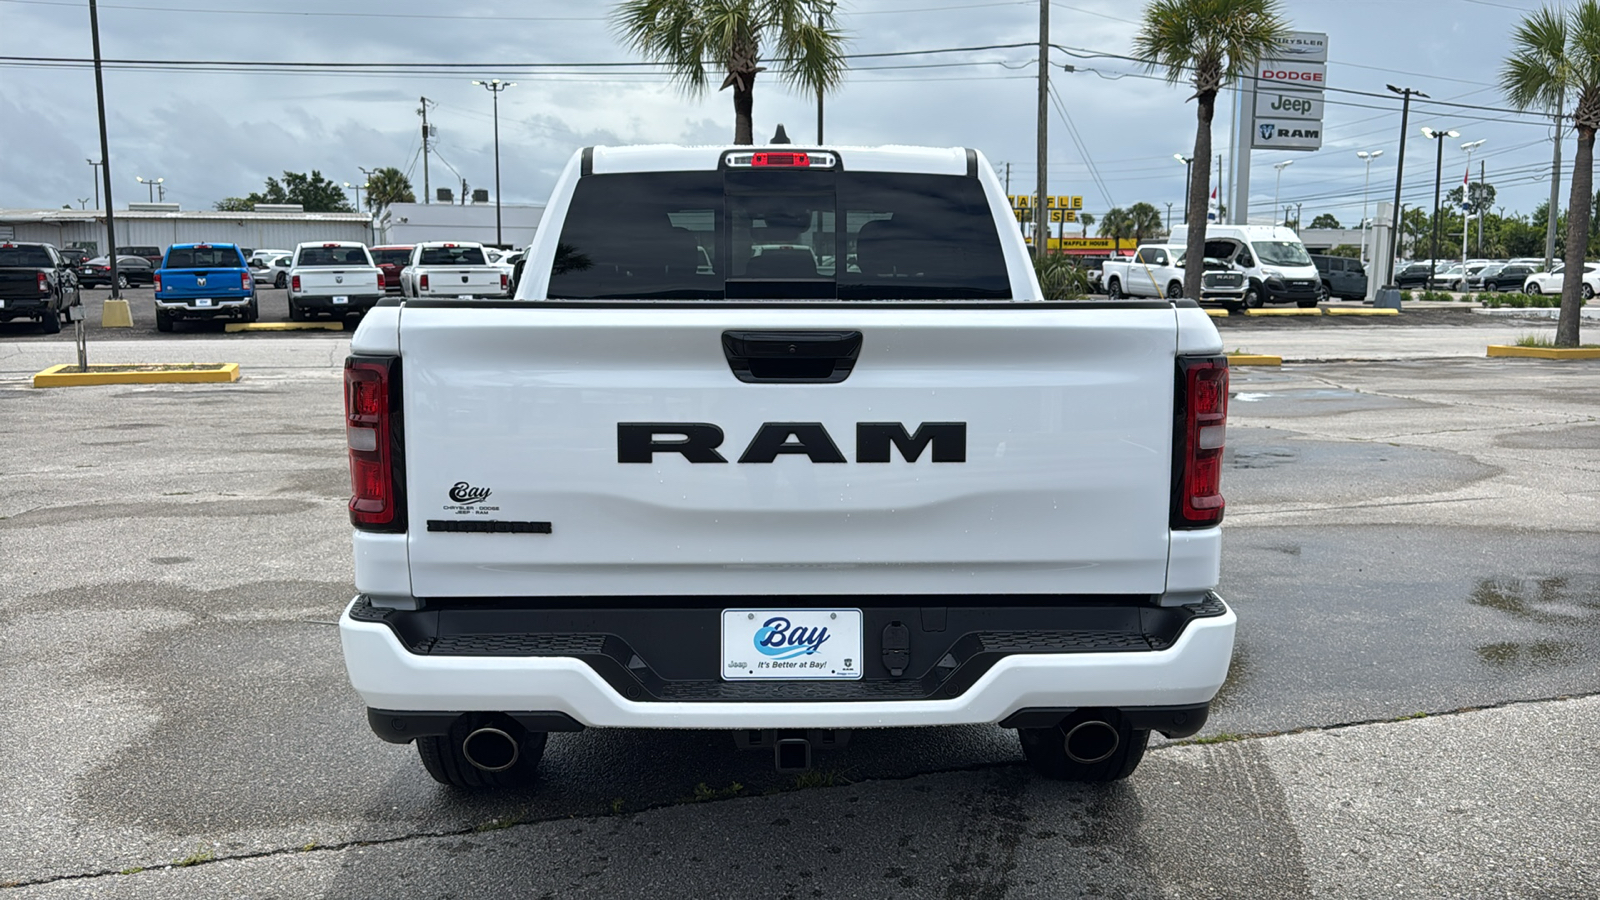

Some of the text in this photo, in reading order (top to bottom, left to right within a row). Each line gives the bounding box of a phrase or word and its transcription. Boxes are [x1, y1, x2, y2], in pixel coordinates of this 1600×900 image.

[1272, 38, 1323, 46] HRYSLER
[1262, 70, 1323, 82] DODGE
[1271, 94, 1312, 115] Jeep
[1277, 128, 1319, 139] RAM
[617, 421, 967, 464] RAM
[451, 481, 493, 503] Bay
[758, 616, 831, 655] Bay
[758, 661, 828, 669] It's Better at Bay!
